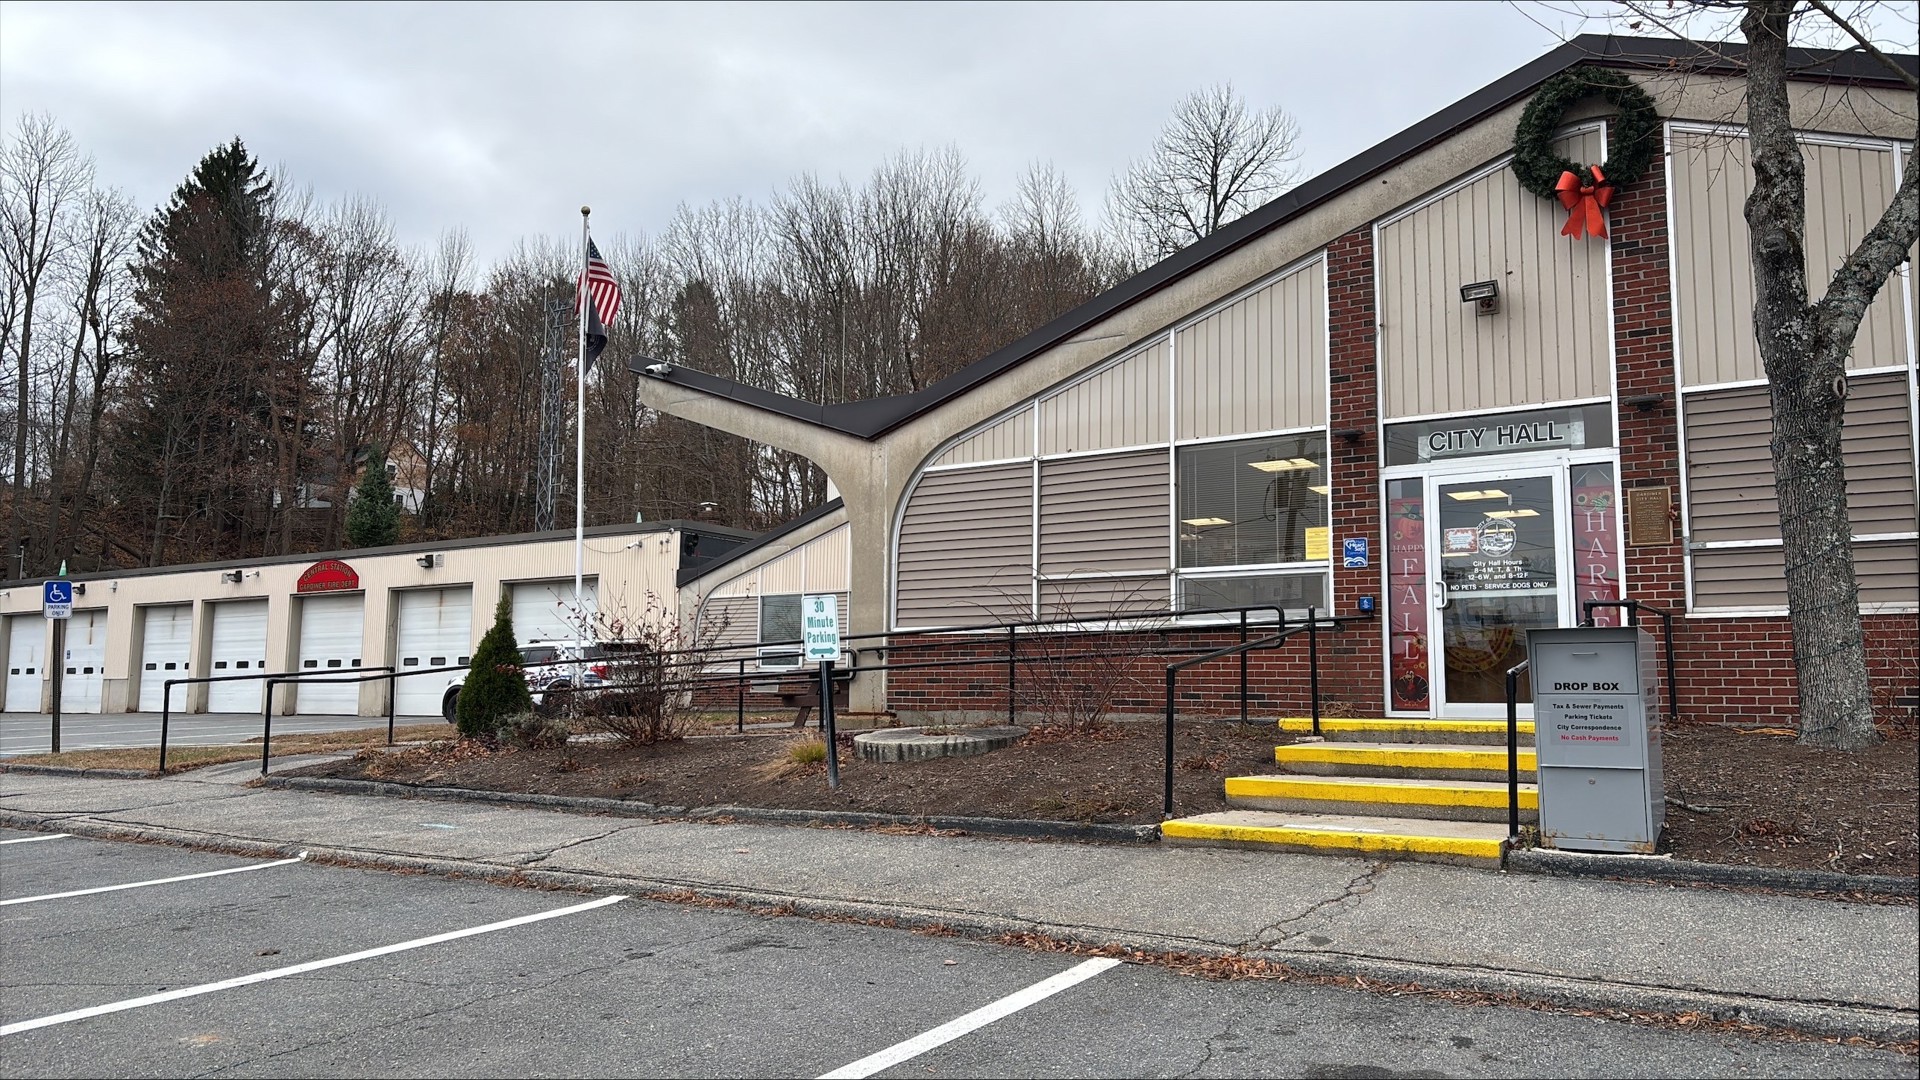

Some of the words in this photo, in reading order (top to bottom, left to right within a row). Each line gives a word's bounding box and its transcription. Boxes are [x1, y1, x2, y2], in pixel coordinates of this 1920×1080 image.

[1428, 427, 1487, 453] CITY
[1497, 421, 1564, 446] HALL
[303, 563, 328, 582] CENTRAL
[330, 563, 352, 578] STATION
[814, 601, 825, 613] 30
[1401, 557, 1420, 660] FALL
[807, 615, 834, 629] Minute
[807, 631, 837, 645] Parking
[1554, 682, 1589, 691] DROP
[1592, 682, 1620, 691] BOX
[1593, 703, 1624, 711] Payments
